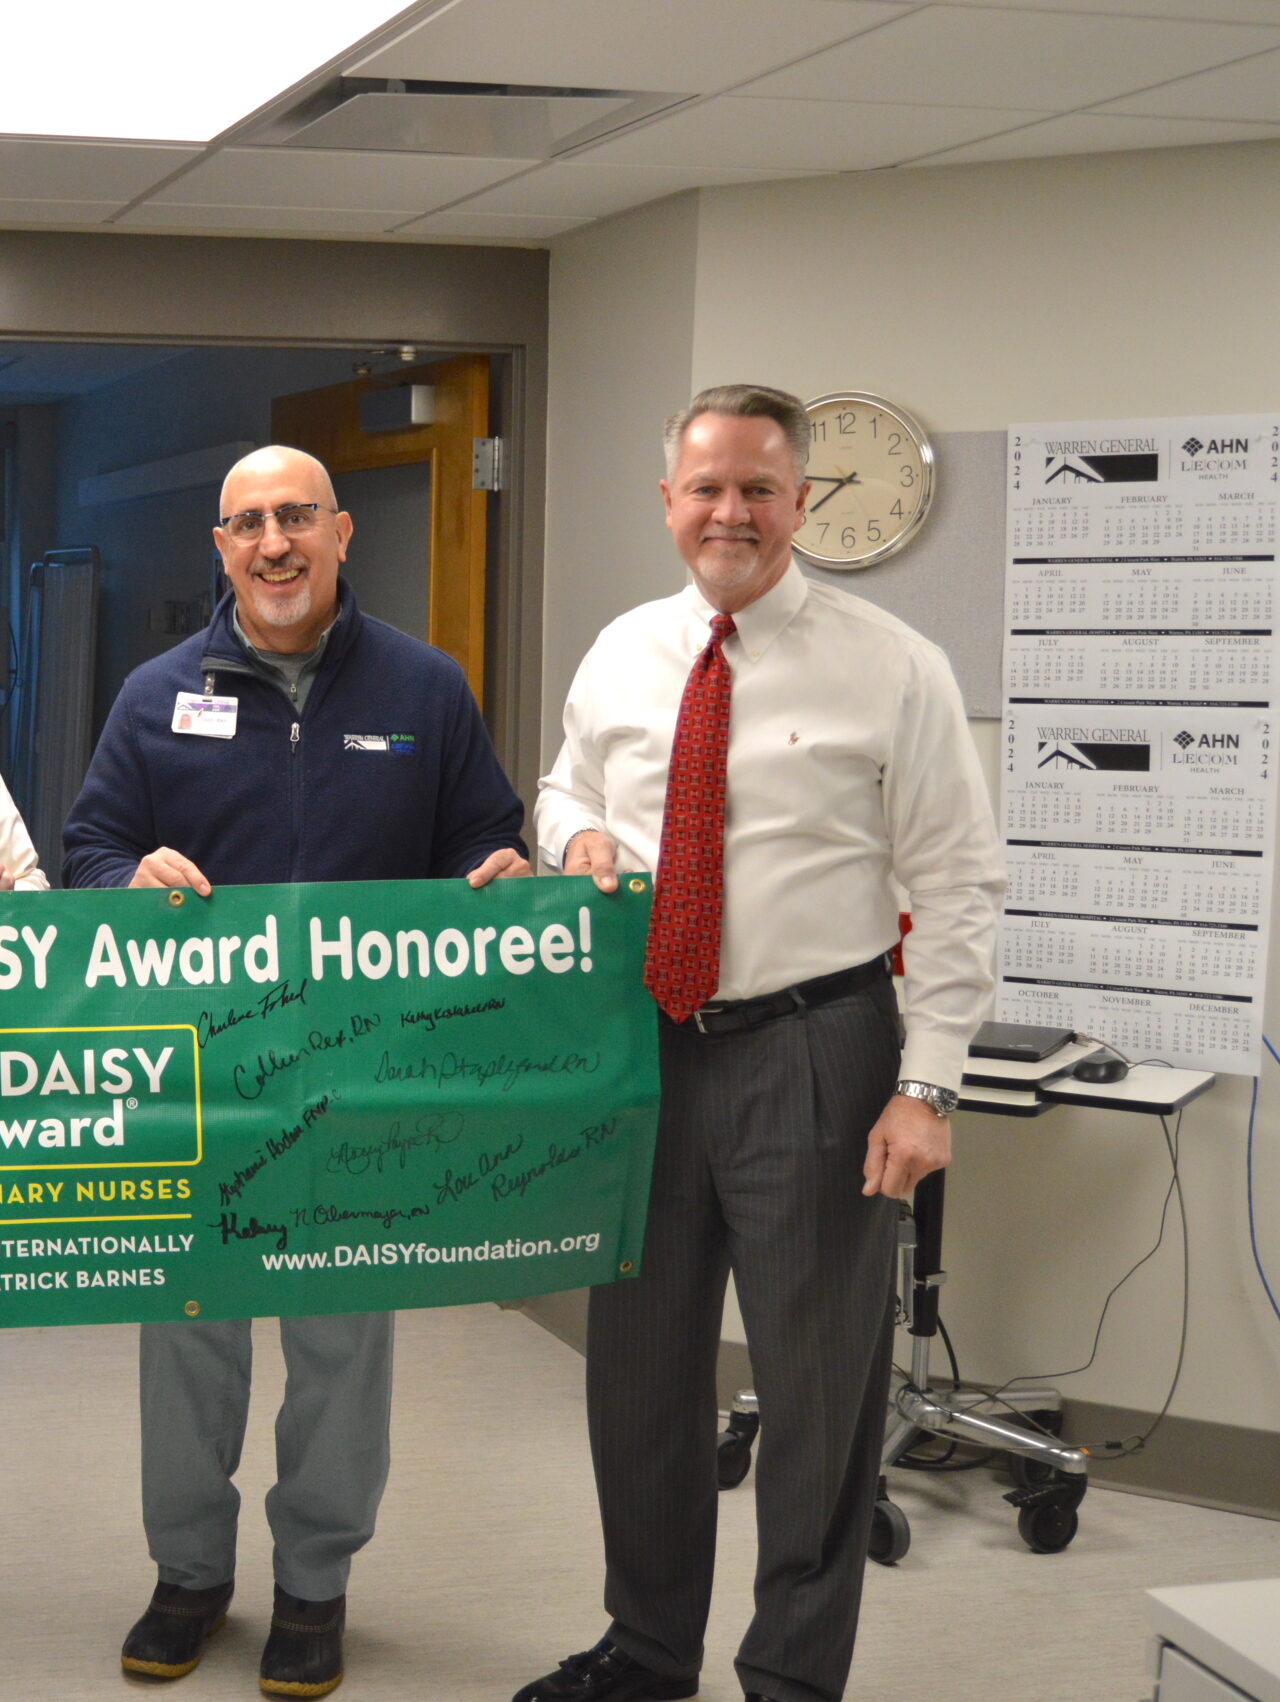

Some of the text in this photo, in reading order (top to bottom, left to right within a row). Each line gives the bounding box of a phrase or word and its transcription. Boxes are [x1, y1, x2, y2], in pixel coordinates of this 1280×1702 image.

[835, 412, 856, 434] 12
[869, 417, 877, 439] 1
[811, 421, 826, 442] 11
[887, 433, 902, 455] 2
[1045, 438, 1159, 455] WARREN GENERAL
[1206, 438, 1249, 454] AHN
[900, 465, 914, 488] 3
[1198, 473, 1229, 481] HEALTH
[1032, 497, 1072, 506] JANUARY
[1121, 495, 1168, 504] FEBRUARY
[1219, 492, 1255, 500] MARCH
[889, 498, 904, 520] 4
[817, 522, 830, 544] 7
[841, 527, 856, 549] 6
[867, 520, 881, 542] 5
[1223, 567, 1247, 575] JUNE
[1205, 638, 1260, 646] SEPTEMBER
[400, 734, 415, 742] AHN
[1037, 727, 1151, 743] WARREN GENERAL
[1198, 734, 1240, 749] AHN
[1025, 781, 1064, 790] JANUARY
[1113, 784, 1160, 793] FEBRUARY
[1210, 787, 1245, 795] MARCH
[1124, 856, 1144, 865] MAY
[1212, 860, 1236, 869] JUNE
[1031, 921, 1051, 929] JULY
[1112, 926, 1148, 934] AUGUST
[1192, 929, 1246, 940] SEPTEMBER
[85, 915, 279, 988] Award
[310, 907, 592, 980] Honoree!
[1018, 990, 1059, 1000] OCTOBER
[1102, 996, 1152, 1007] NOVEMBER
[1188, 1003, 1239, 1015] DECEMBER
[351, 1013, 381, 1036] RN
[0, 1047, 174, 1096] DAISY
[581, 1118, 617, 1149] RN
[77, 1179, 190, 1201] NURSES
[262, 1233, 600, 1270] www.DAISYfoundation.org
[77, 1269, 165, 1287] BARNES
